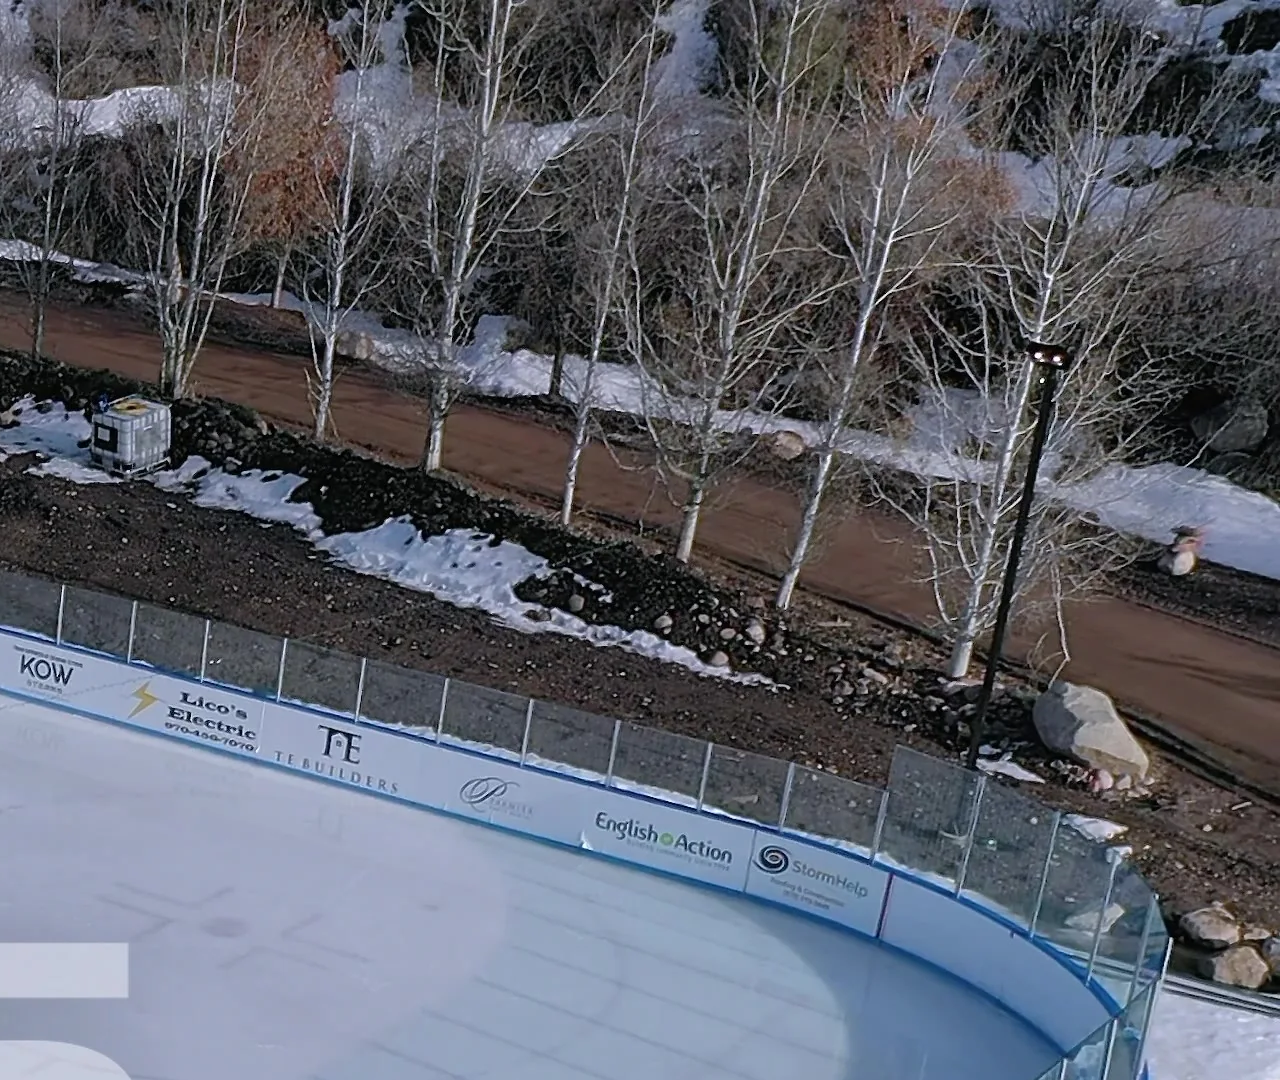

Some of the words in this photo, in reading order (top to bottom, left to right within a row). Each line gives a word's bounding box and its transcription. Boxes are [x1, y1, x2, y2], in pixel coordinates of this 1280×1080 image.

[20, 653, 75, 687] KOW
[167, 706, 258, 741] Electric
[180, 692, 249, 721] Lico's
[595, 811, 660, 843] English
[674, 833, 733, 864] Action
[792, 860, 869, 898] StormHelp
